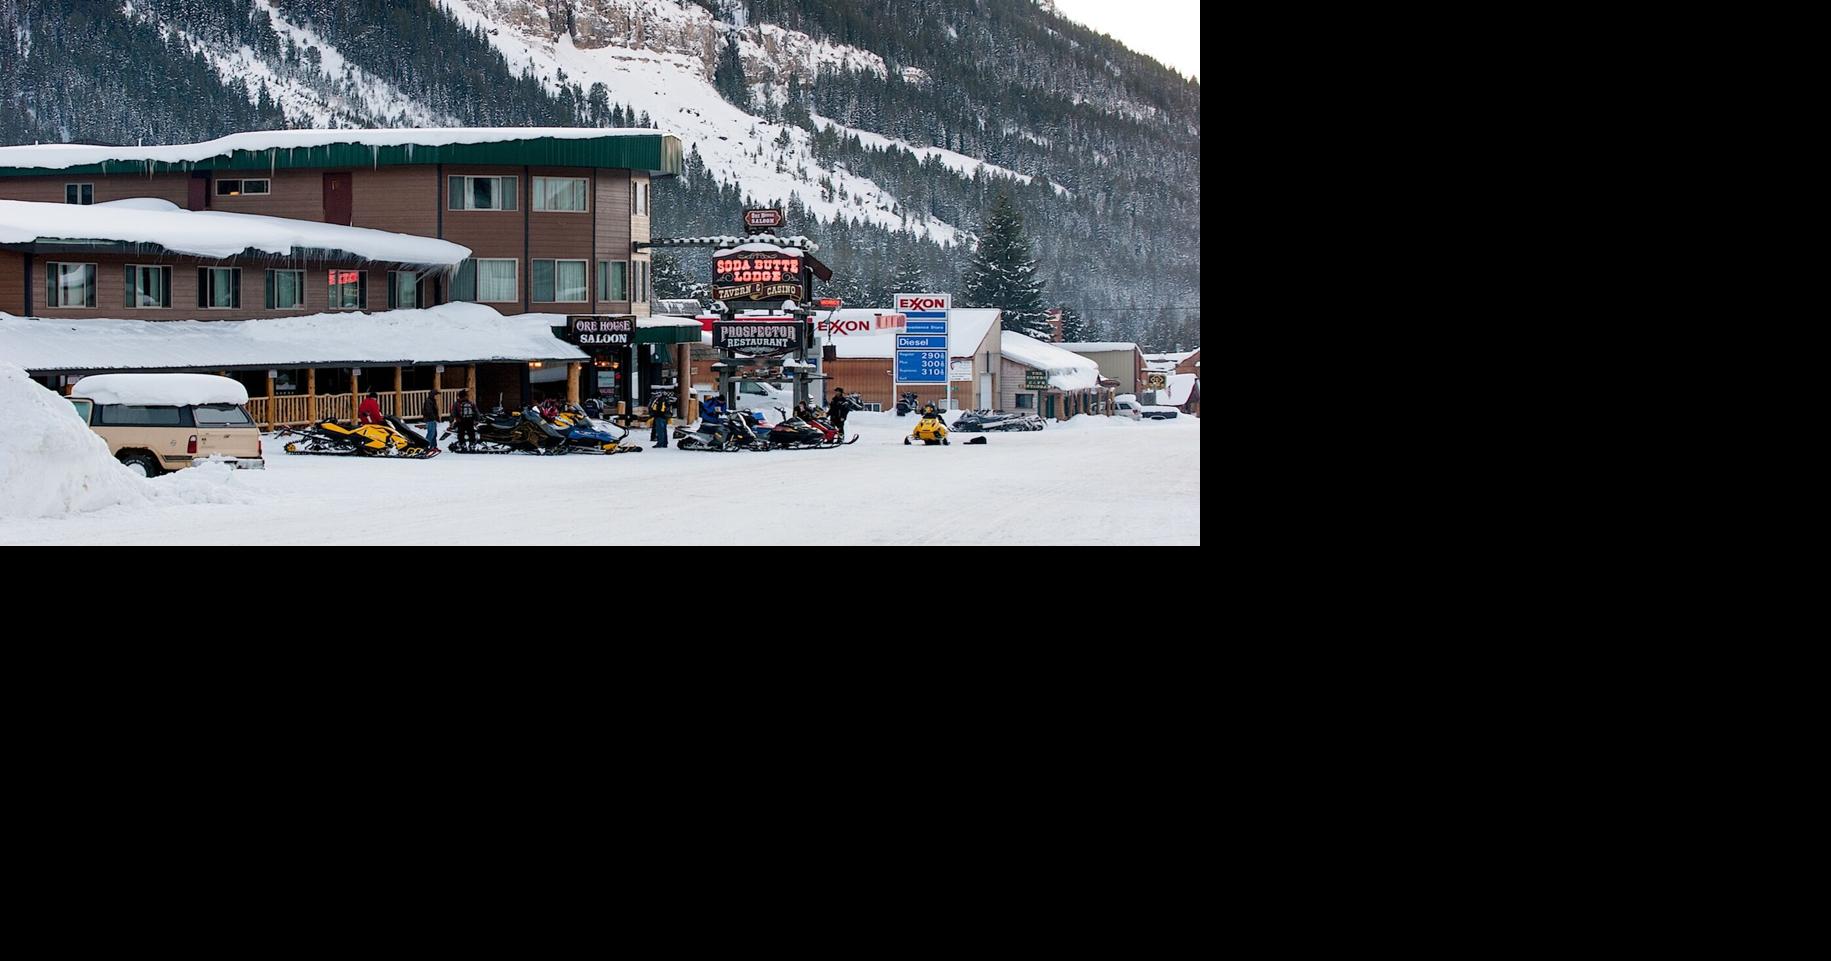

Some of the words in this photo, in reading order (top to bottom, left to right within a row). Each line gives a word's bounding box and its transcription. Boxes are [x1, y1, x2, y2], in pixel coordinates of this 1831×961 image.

[717, 259, 751, 274] SODA
[754, 259, 799, 274] BUTTE
[734, 271, 781, 282] LODGE
[718, 285, 752, 299] TAVERN
[766, 285, 796, 296] CASINO
[900, 297, 945, 311] EXXON
[576, 320, 598, 333] ORE
[600, 320, 631, 332] HOUSE
[817, 319, 870, 336] EXXON
[580, 333, 628, 344] SALOON
[720, 325, 797, 343] PROSPECTOR
[727, 338, 789, 348] RESTAURANT
[899, 338, 929, 346] Diesel
